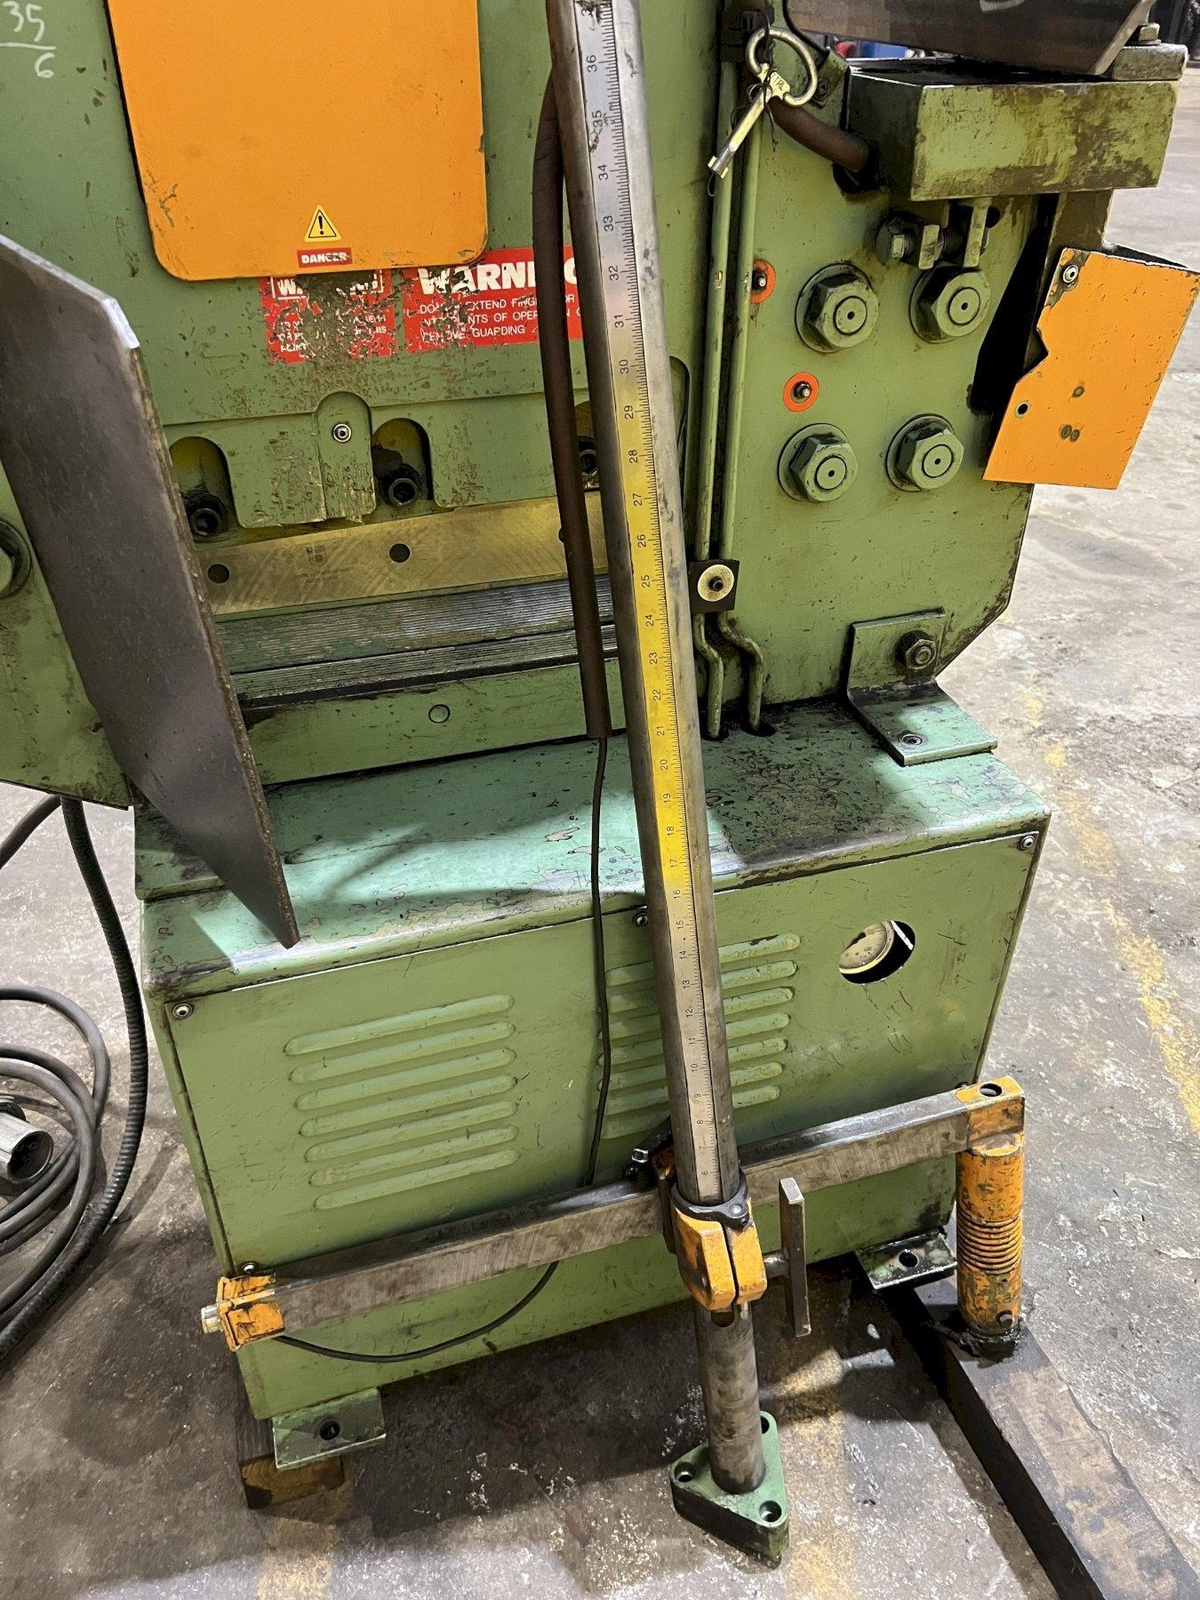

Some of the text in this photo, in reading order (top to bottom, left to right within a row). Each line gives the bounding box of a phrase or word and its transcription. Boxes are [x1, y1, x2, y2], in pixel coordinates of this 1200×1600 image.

[2, 0, 45, 42] 35
[34, 52, 55, 78] 6
[586, 54, 598, 72] 36
[598, 164, 608, 180] 34
[603, 215, 614, 232] 33
[301, 252, 348, 264] DANGER
[608, 265, 620, 281] 32
[466, 299, 507, 312] EXTEND
[494, 313, 508, 323] OF
[614, 314, 624, 328] 31
[619, 359, 629, 374] 30
[624, 405, 634, 420] 29
[628, 450, 638, 464] 28
[633, 493, 643, 506] 27
[637, 534, 646, 548] 26
[641, 574, 651, 588] 25
[645, 614, 654, 627] 24
[649, 652, 658, 664] 23
[653, 689, 662, 701] 22
[656, 725, 665, 736] 21
[660, 759, 668, 771] 20
[663, 793, 671, 804] 19
[666, 826, 674, 836] 18
[670, 858, 678, 868] 17
[673, 889, 680, 900] 16
[676, 920, 684, 930] 15
[680, 950, 687, 960] 14
[682, 980, 690, 989] 13
[685, 1008, 694, 1018] 12
[691, 1063, 698, 1072] 10
